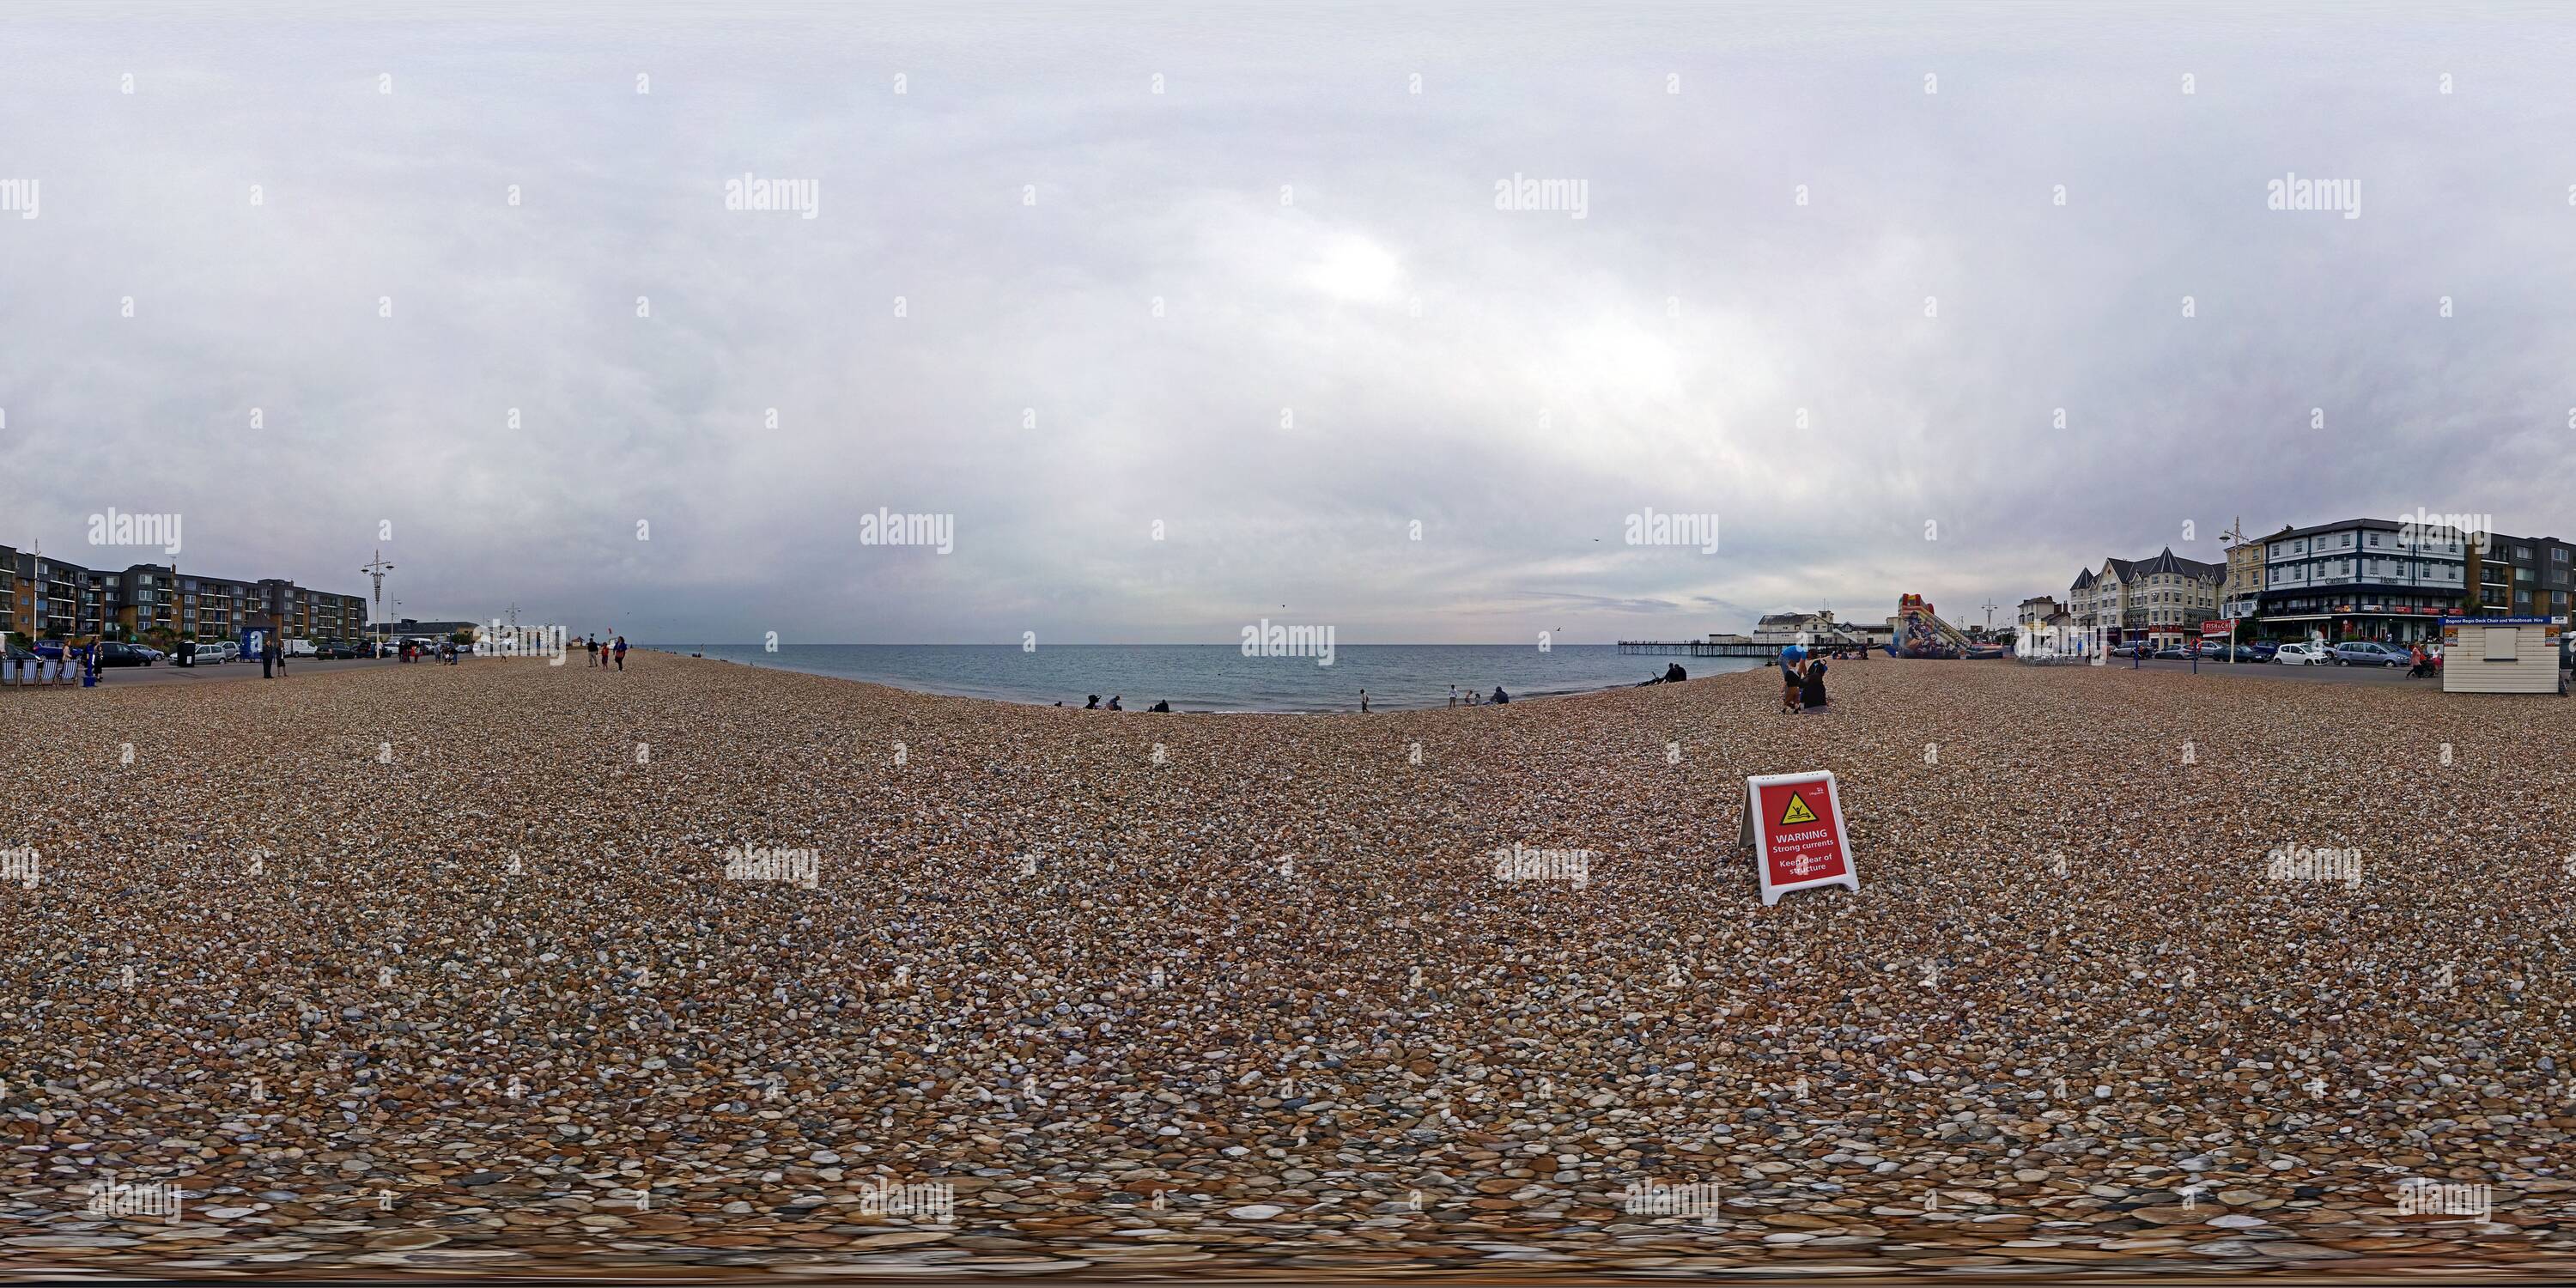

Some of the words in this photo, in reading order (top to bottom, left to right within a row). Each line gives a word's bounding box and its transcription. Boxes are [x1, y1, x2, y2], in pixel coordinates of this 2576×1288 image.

[1776, 829, 1827, 843] WARNING
[1773, 844, 1801, 854] Strong
[1802, 839, 1834, 849] currents
[1779, 860, 1801, 868] Keep
[1803, 856, 1822, 865] clear
[1824, 853, 1832, 861] of
[1789, 864, 1826, 875] structure
